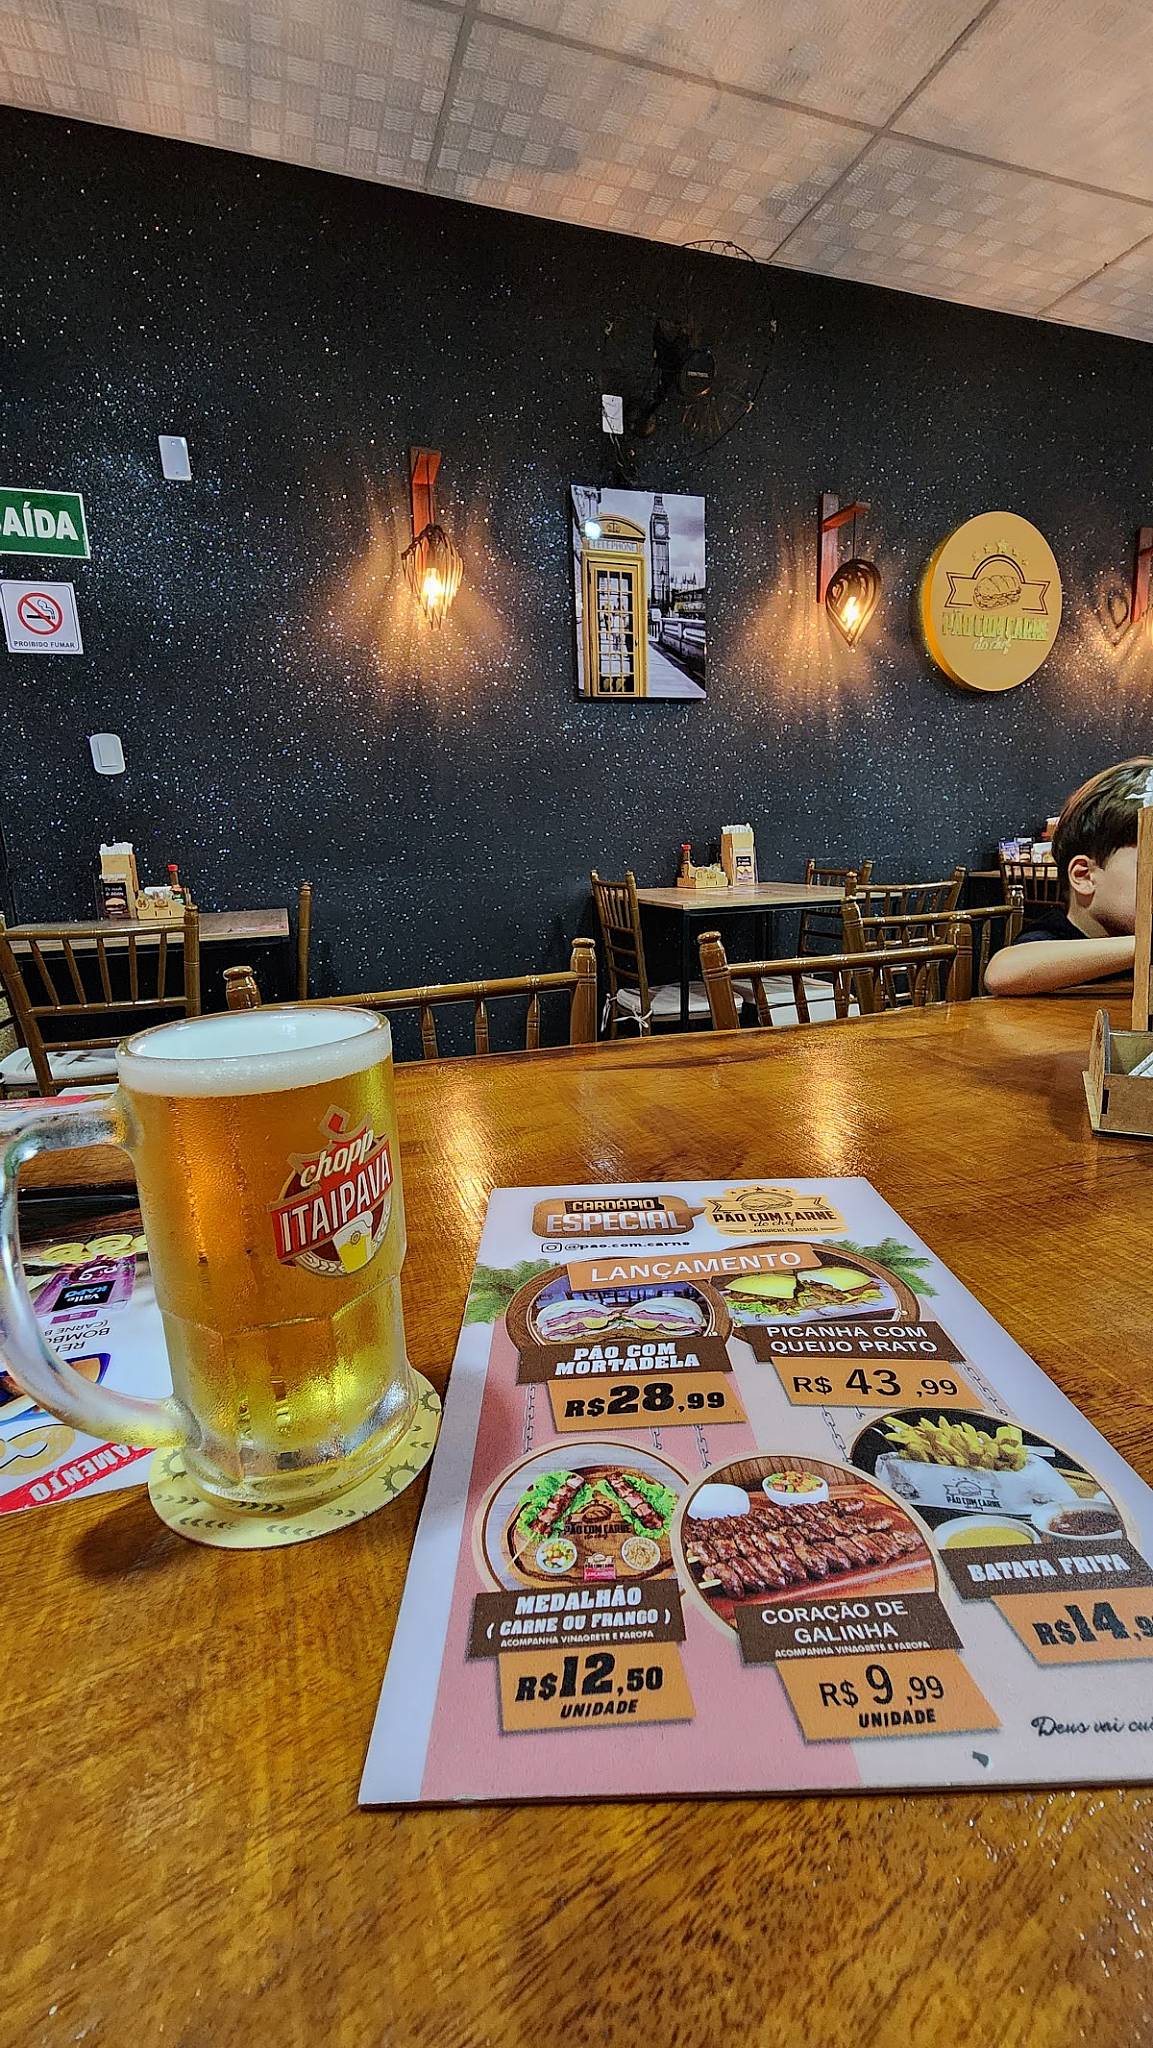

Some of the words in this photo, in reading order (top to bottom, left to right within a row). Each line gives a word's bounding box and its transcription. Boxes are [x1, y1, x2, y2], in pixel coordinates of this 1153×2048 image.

[0, 501, 79, 541] AÍDA
[13, 640, 49, 648] PROIBIDO
[50, 641, 76, 649] FUMAR
[300, 1129, 374, 1187] chopp
[280, 1149, 391, 1252] ITAIPAVA
[546, 1210, 687, 1233] ESPECIAL
[712, 1211, 747, 1223] PÃO
[748, 1212, 783, 1223] COM
[784, 1210, 837, 1221] CARNE
[590, 1251, 802, 1283] LANÇAMENTO
[765, 1325, 870, 1338] PICANHA
[873, 1325, 928, 1338] COM
[574, 1344, 619, 1361] PÃO
[627, 1342, 677, 1358] COM
[770, 1340, 853, 1354] QUEIJO
[857, 1340, 938, 1353] PRATO
[554, 1352, 701, 1376] MORTADELA
[793, 1376, 833, 1395] R$
[967, 1558, 1058, 1583] BATATA
[1058, 1553, 1132, 1575] FRITA
[514, 1585, 642, 1616] MEDALHÃO
[761, 1600, 870, 1625] CORAÇÃO
[874, 1599, 909, 1616] DE
[500, 1616, 559, 1637] CARNE
[562, 1614, 586, 1631] OU
[590, 1608, 659, 1629] FRANGO
[794, 1621, 899, 1645] GALINHA
[1032, 1600, 1153, 1646] R$14,9
[500, 1636, 559, 1648] ACOMPANHA
[561, 1631, 611, 1644] VINAGRETE
[612, 1631, 619, 1641] E
[620, 1629, 654, 1640] FAROFA
[775, 1646, 834, 1658] ACOMPANHA
[836, 1642, 885, 1655] VINAGRETE
[887, 1643, 894, 1652] E
[896, 1639, 931, 1651] FAROFA
[818, 1679, 859, 1708] R$
[560, 1699, 639, 1719] UNIDADE
[858, 1707, 937, 1729] UNIDADE
[1030, 1715, 1091, 1737] Deus
